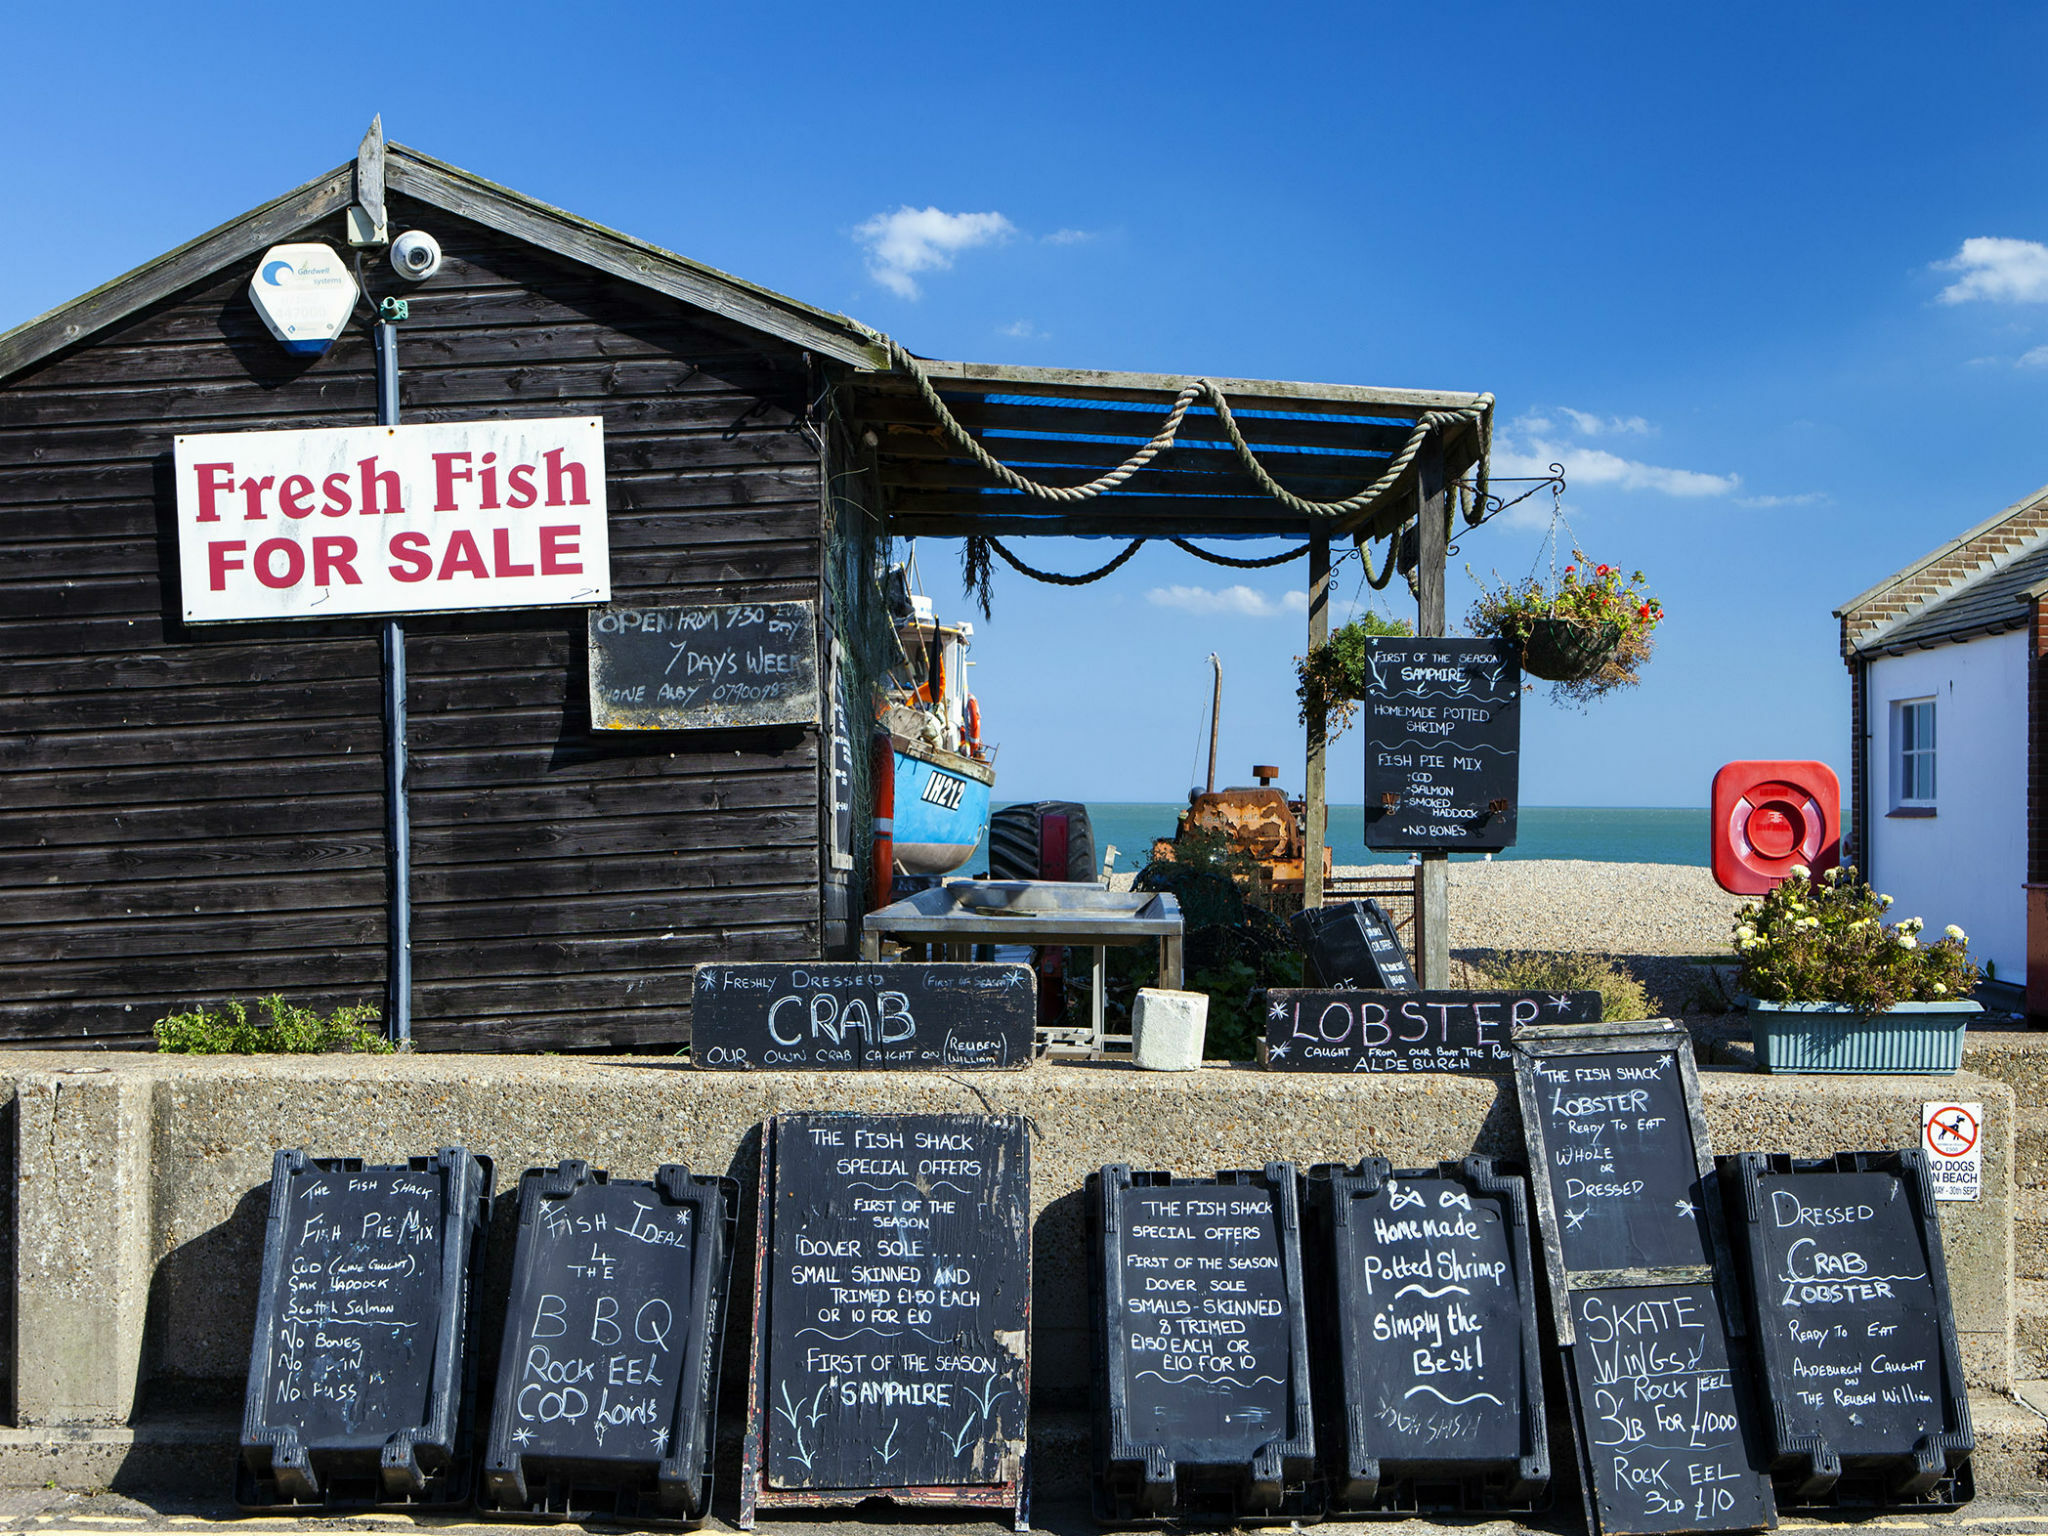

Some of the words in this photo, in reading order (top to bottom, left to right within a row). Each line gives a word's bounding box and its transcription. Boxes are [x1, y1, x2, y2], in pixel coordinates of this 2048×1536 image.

[194, 455, 405, 522] Fresh
[431, 447, 590, 511] Fish
[207, 534, 362, 592] FOR
[388, 524, 584, 584] SALE
[598, 611, 673, 634] OPEN
[678, 607, 719, 632] FROM
[665, 641, 687, 675] 7
[1374, 652, 1407, 663] FIRST
[1413, 653, 1427, 663] OF
[1434, 654, 1451, 663] THE
[1459, 654, 1500, 664] SEASON
[1401, 667, 1467, 682] SAMPHIRE
[1375, 705, 1436, 718] HOMEMADE
[1444, 708, 1490, 722] POTTED
[1407, 722, 1455, 736] SHRIMP
[1378, 754, 1412, 767] FISH
[1421, 755, 1445, 768] PIE
[1454, 757, 1482, 771] MIX
[922, 771, 966, 810] IH212
[1433, 809, 1478, 818] HADDOCK
[1429, 826, 1467, 836] BONES
[724, 971, 777, 992] FRESHLY
[792, 970, 884, 989] DRESSED
[768, 992, 916, 1046] CRAB
[1292, 1000, 1540, 1048] LOBSTER
[707, 1046, 746, 1064] OUR
[764, 1050, 806, 1063] OWN
[816, 1049, 852, 1062] CRAB
[921, 1051, 940, 1059] ON
[1305, 1047, 1351, 1057] CAUGHT
[1409, 1047, 1431, 1057] OUR
[1465, 1047, 1484, 1058] THE
[1541, 1070, 1570, 1083] THE
[1576, 1069, 1611, 1081] FISH
[1617, 1068, 1661, 1080] SHACK
[1552, 1088, 1648, 1116] LOBSTER
[809, 1129, 844, 1146] THE
[855, 1130, 904, 1149] FISH
[915, 1133, 974, 1150] SHACK
[1569, 1120, 1604, 1143] READY
[1611, 1119, 1627, 1130] TO
[1638, 1118, 1666, 1130] EAT
[1556, 1148, 1614, 1165] WHOLE
[1945, 1161, 1974, 1171] DOGS
[837, 1159, 908, 1175] SPECIAL
[919, 1160, 981, 1176] OFFERS
[1601, 1163, 1614, 1173] OR
[1943, 1173, 1977, 1183] BEACH
[301, 1180, 330, 1200] THE
[349, 1180, 377, 1192] FISH
[390, 1179, 433, 1199] SHACK
[1565, 1178, 1644, 1199] DRESSED
[854, 1198, 895, 1212] FIRST
[901, 1200, 921, 1212] OF
[929, 1201, 955, 1214] THE
[1142, 1201, 1180, 1216] THE
[1187, 1200, 1226, 1216] FISH
[1230, 1202, 1273, 1215] SHACK
[1772, 1191, 1873, 1227] DRESSED
[615, 1201, 686, 1248] IDEAL
[873, 1216, 929, 1229] SEASON
[1133, 1226, 1195, 1239] SPECIAL
[1205, 1227, 1260, 1240] OFFERS
[591, 1243, 616, 1265] 4
[800, 1240, 861, 1257] DOVER
[1127, 1255, 1168, 1268] FIRST
[1174, 1258, 1193, 1269] OF
[1198, 1258, 1223, 1269] THE
[1228, 1257, 1278, 1269] SEASON
[1787, 1238, 1867, 1281] CRAB
[567, 1265, 614, 1279] THE
[792, 1266, 841, 1284] SMALL
[852, 1266, 920, 1283] SKINNED
[934, 1268, 970, 1286] AND
[1364, 1249, 1433, 1294] Potted
[1437, 1248, 1506, 1286] Shrimp
[1146, 1278, 1197, 1292] DOVER
[1210, 1280, 1247, 1292] SOLE
[1782, 1282, 1895, 1305] LOBSTER
[830, 1288, 890, 1304] TRIMED
[940, 1291, 980, 1307] EACH
[1128, 1298, 1191, 1314] SMALLS
[1203, 1300, 1282, 1316] SKINNED
[818, 1308, 840, 1321] OR
[852, 1310, 865, 1322] 10
[871, 1309, 900, 1323] FOR
[1374, 1305, 1442, 1348] Simply
[1447, 1303, 1483, 1336] the
[1583, 1297, 1705, 1343] SKATE
[1176, 1320, 1245, 1336] TRIMED
[1789, 1320, 1828, 1348] READY
[1834, 1326, 1847, 1338] TO
[1868, 1322, 1897, 1337] EAT
[1171, 1339, 1213, 1355] EACH
[1227, 1340, 1250, 1353] OR
[523, 1345, 594, 1383] ROCK
[609, 1353, 663, 1385] EEL
[807, 1348, 865, 1373] FIRST
[871, 1356, 895, 1371] OF
[901, 1356, 929, 1371] THE
[935, 1356, 996, 1373] SEASON
[1199, 1355, 1235, 1372] FOR
[1240, 1355, 1256, 1369] 10
[1413, 1336, 1484, 1381] Best!
[1794, 1357, 1861, 1377] ALDEBURGH
[1871, 1355, 1926, 1374] CAUGHT
[841, 1382, 952, 1406] SAMPHIRE
[1634, 1375, 1687, 1402] ROCK
[1701, 1375, 1732, 1391] EEL
[1797, 1391, 1824, 1405] THE
[1834, 1388, 1876, 1407] REUBEN
[517, 1384, 589, 1422] COD
[1655, 1404, 1686, 1432] FOR
[1614, 1456, 1670, 1491] ROCK
[1688, 1464, 1740, 1485] EEL
[1695, 1488, 1735, 1520] £10
